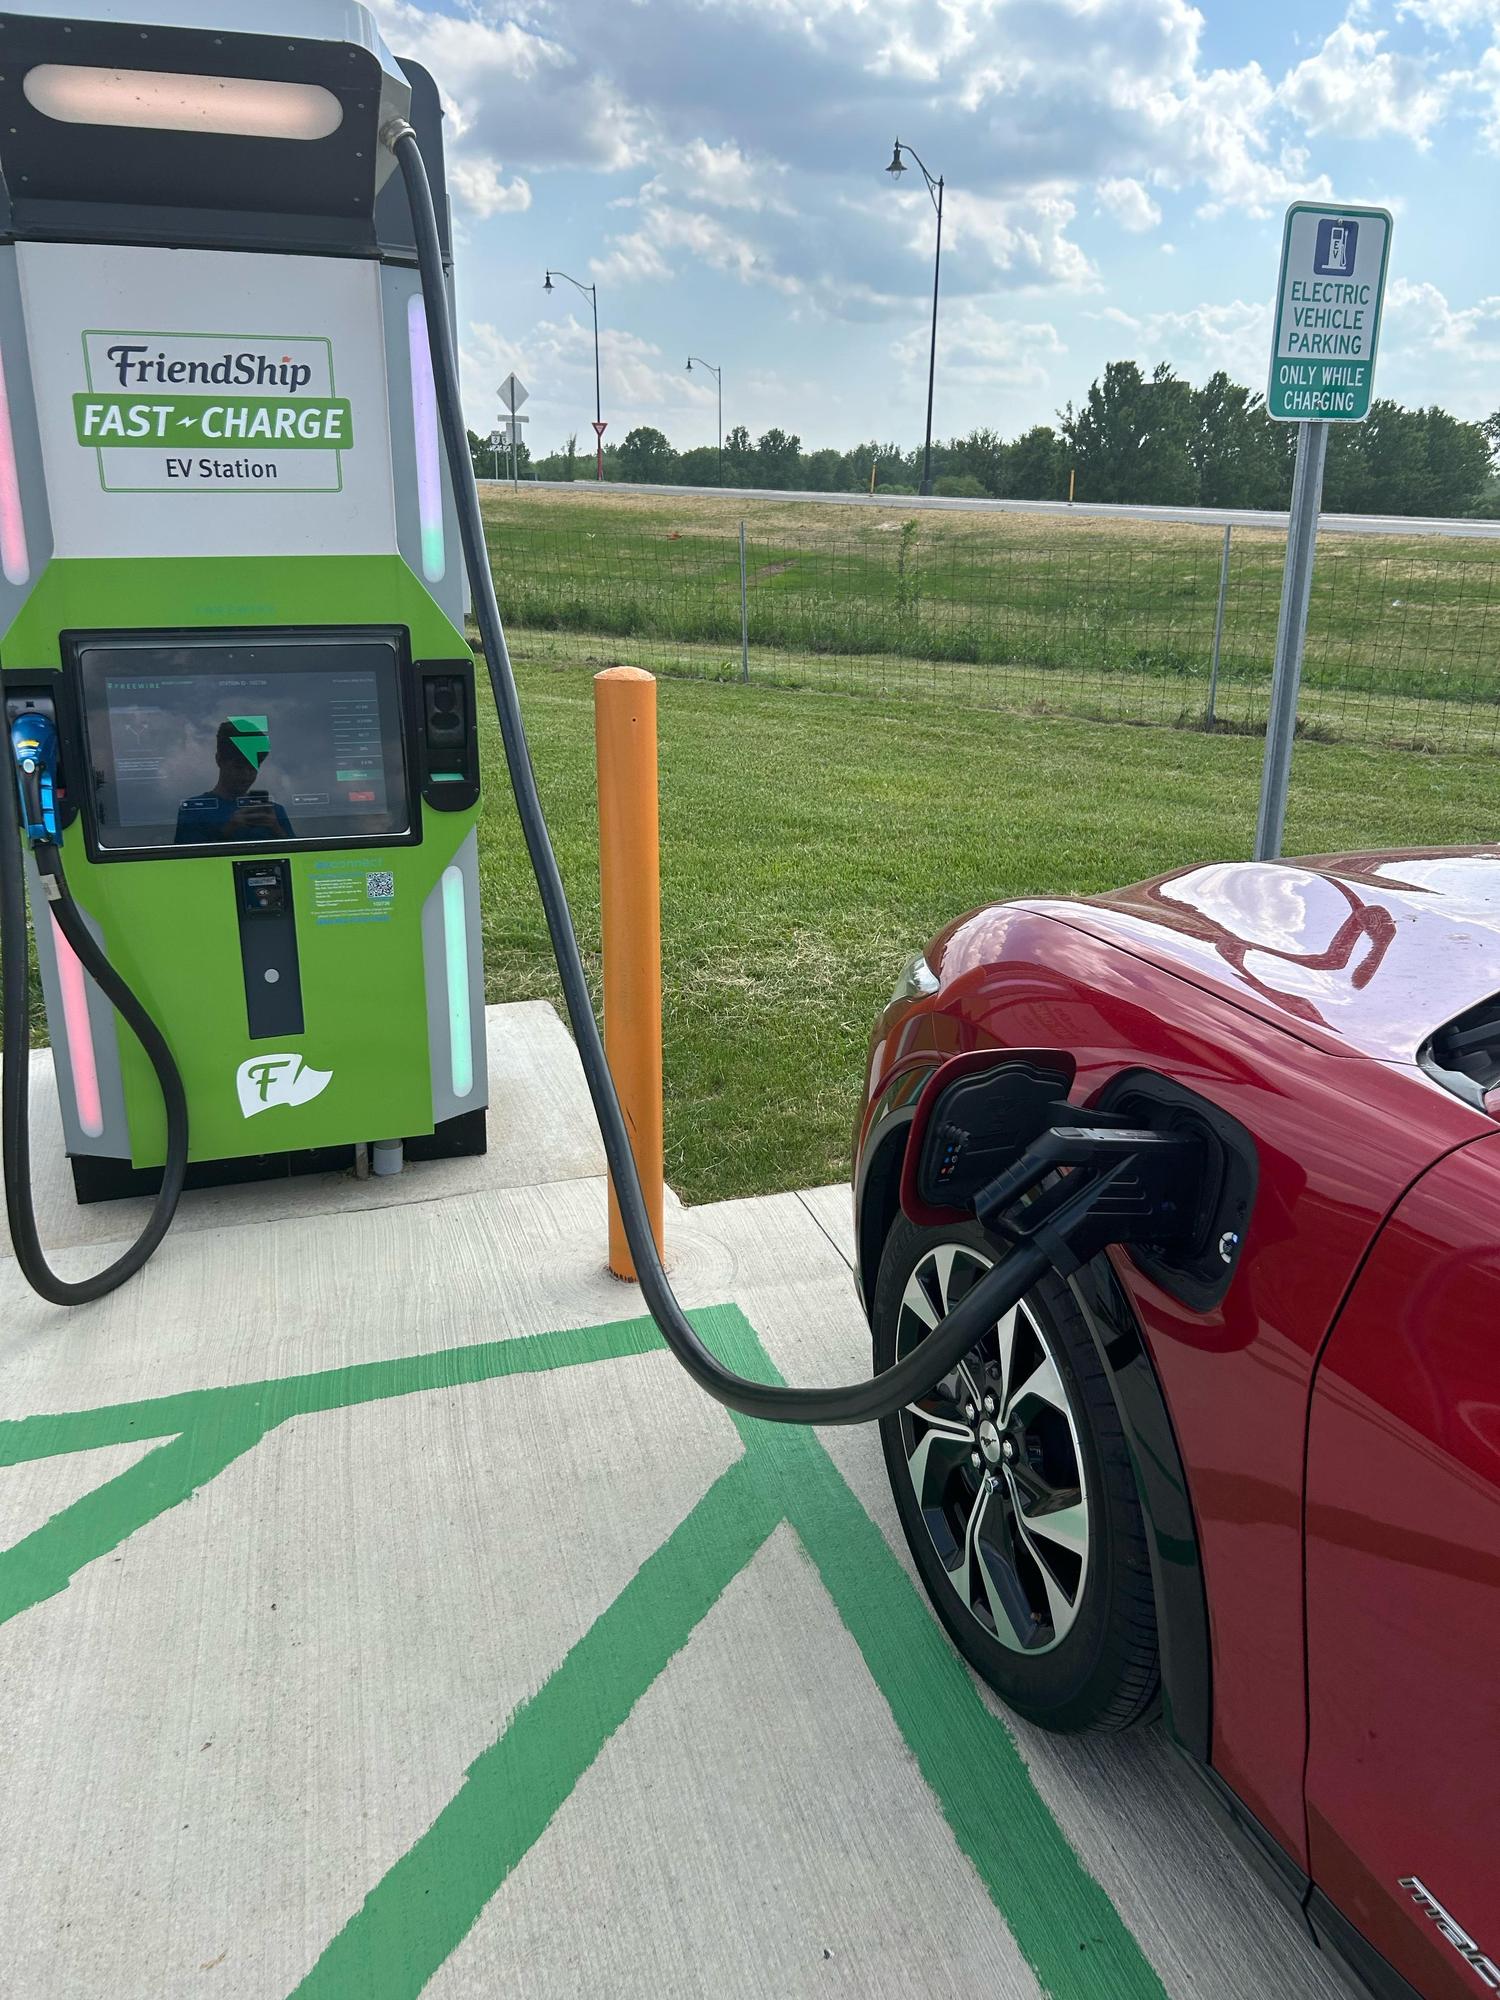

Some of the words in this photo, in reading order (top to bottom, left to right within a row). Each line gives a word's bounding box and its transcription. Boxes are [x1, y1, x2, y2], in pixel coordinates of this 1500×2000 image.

[1291, 281, 1370, 305] ELECTRIC
[1293, 307, 1364, 330] VEHICLE
[1288, 333, 1362, 355] PARKING
[107, 345, 311, 393] FriendShip
[1279, 365, 1317, 385] ONLY
[1321, 366, 1364, 387] WHILE
[1284, 391, 1354, 411] CHARGING
[82, 404, 175, 437] FAST
[201, 406, 344, 440] CHARGE
[166, 458, 192, 478] EV
[199, 459, 277, 478] Station
[247, 1060, 291, 1102] F
